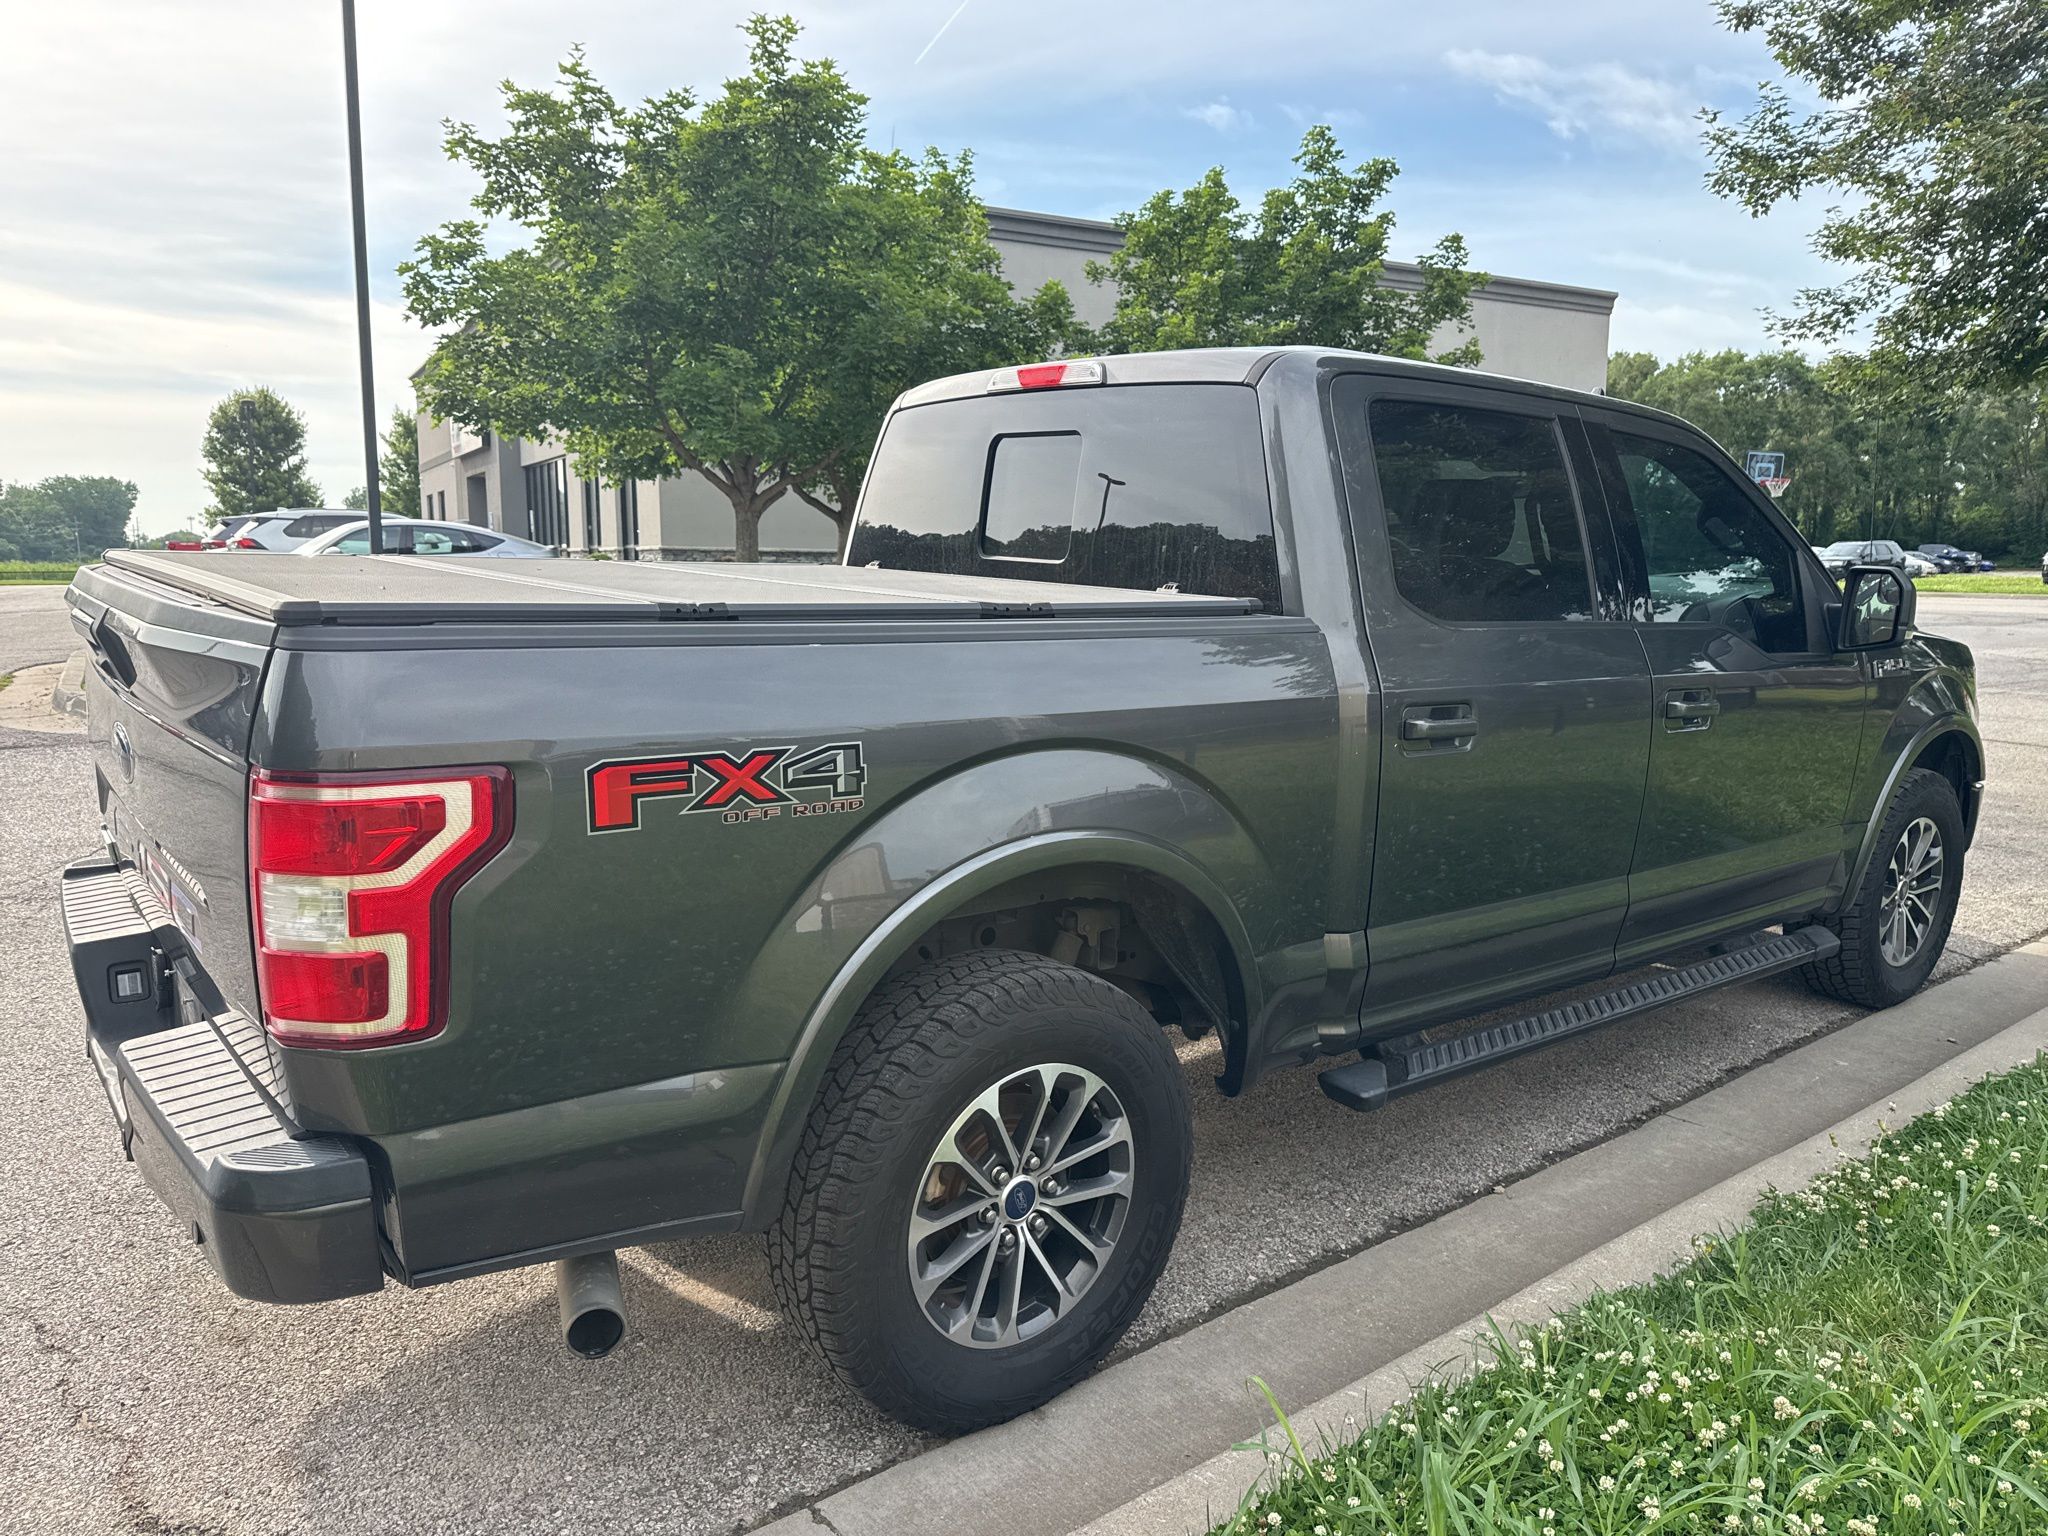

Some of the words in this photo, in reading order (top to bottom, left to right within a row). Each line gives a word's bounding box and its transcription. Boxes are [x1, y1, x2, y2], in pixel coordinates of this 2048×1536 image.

[584, 741, 867, 836] FX4
[721, 805, 781, 824] OFF
[791, 798, 865, 818] ROAD
[1068, 1199, 1169, 1361] COOPER
